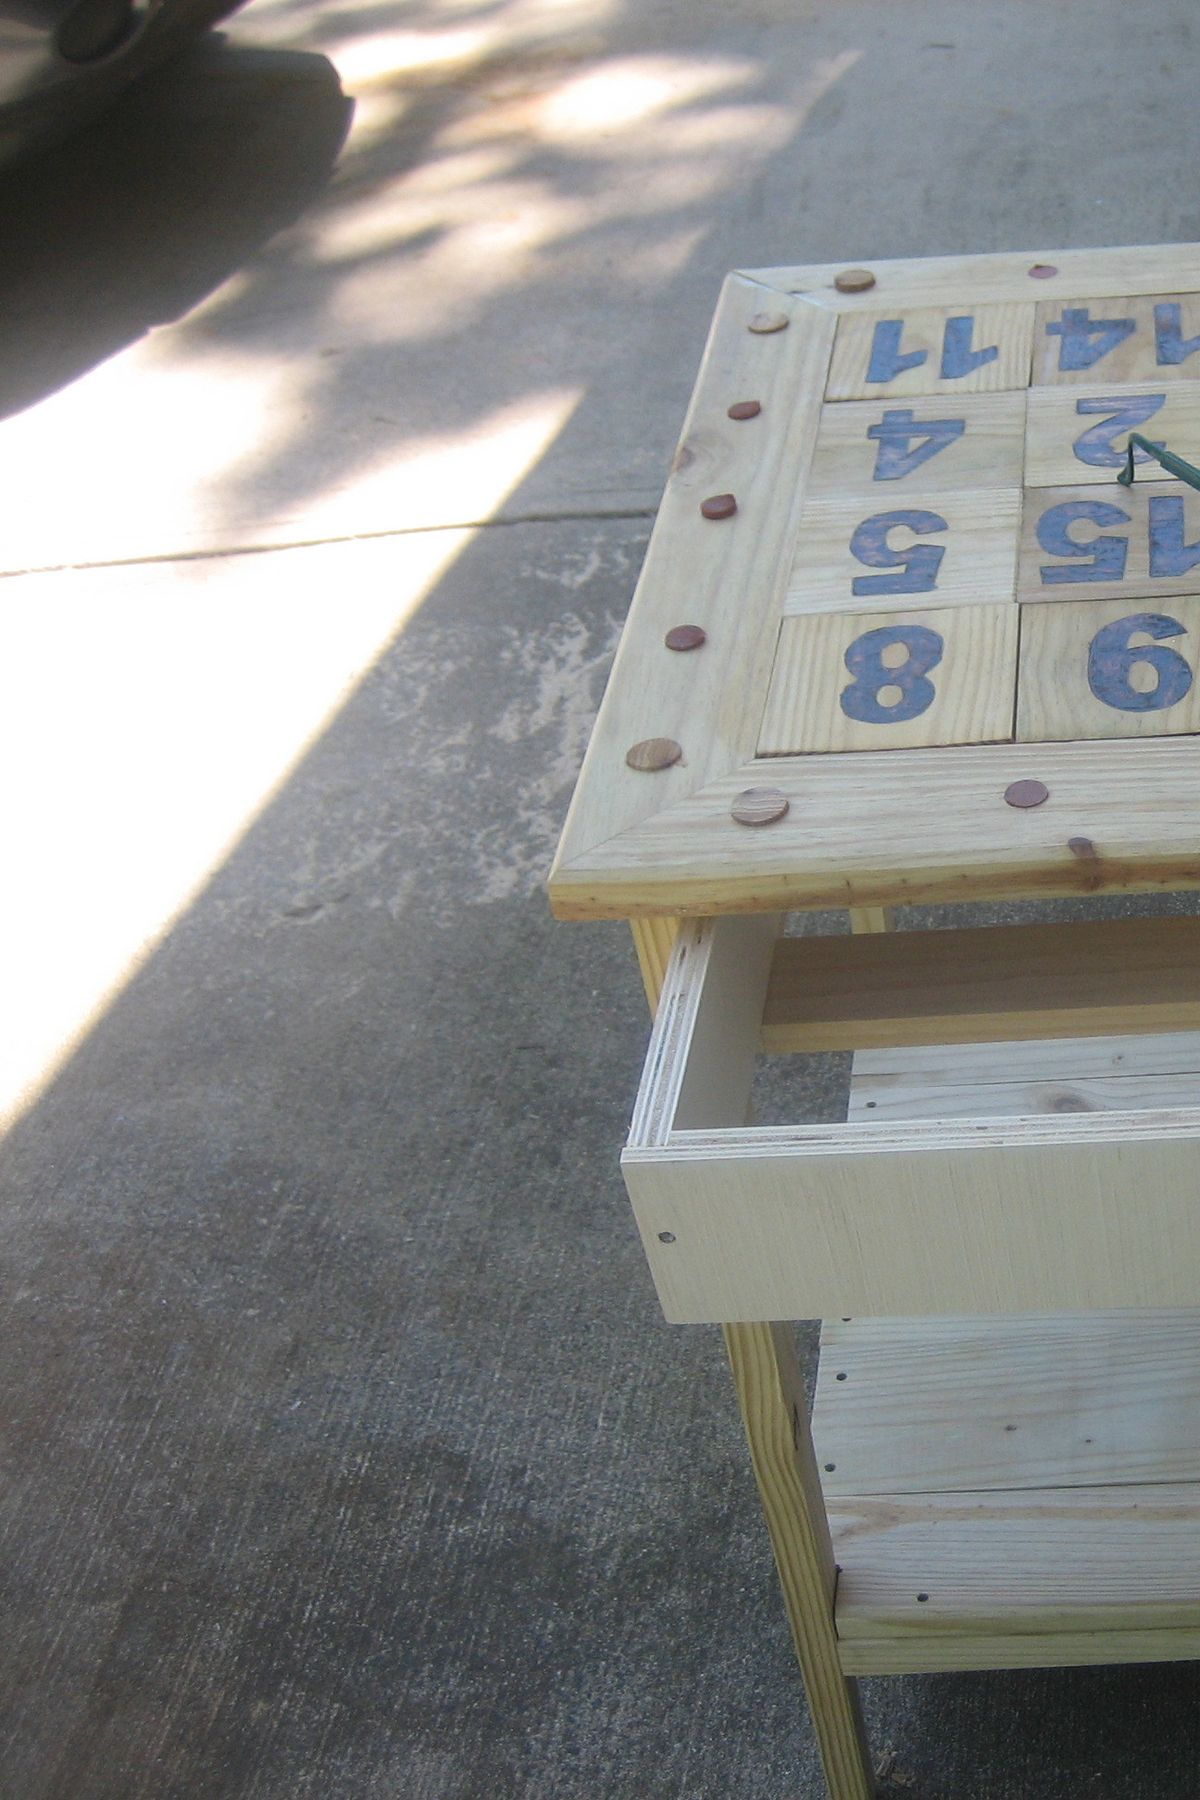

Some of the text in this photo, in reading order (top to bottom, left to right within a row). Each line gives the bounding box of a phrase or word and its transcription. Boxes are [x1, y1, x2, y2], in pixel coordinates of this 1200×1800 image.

[866, 318, 998, 383] 11
[867, 410, 966, 481] 4
[1073, 394, 1166, 468] 2
[849, 509, 949, 596] 5
[840, 624, 944, 724] 8
[1087, 612, 1193, 713] 9
